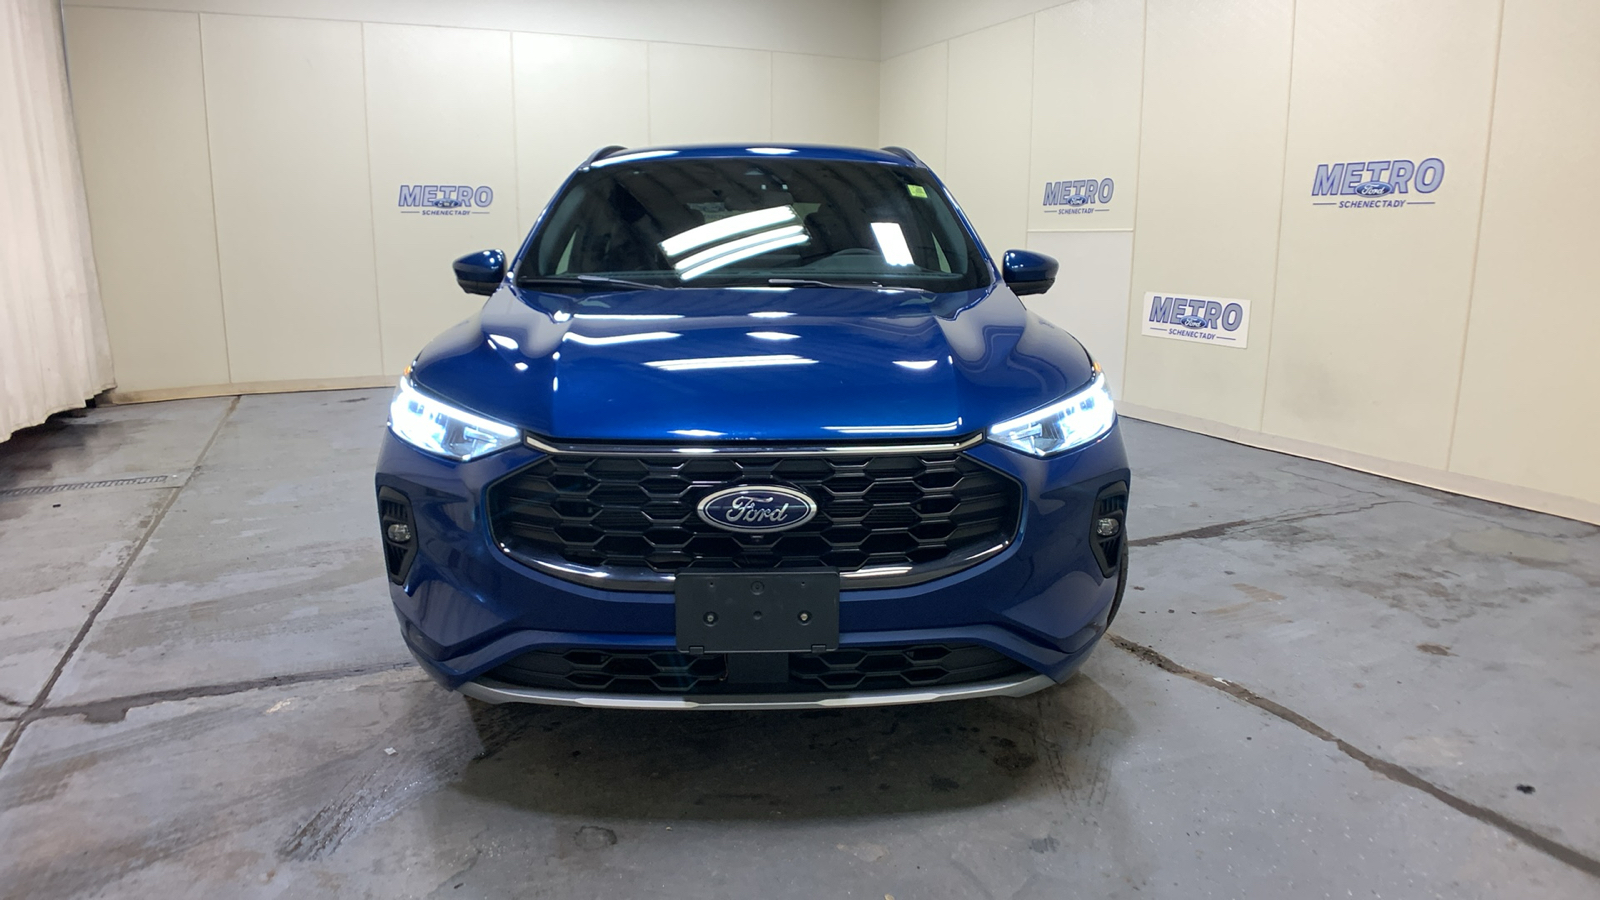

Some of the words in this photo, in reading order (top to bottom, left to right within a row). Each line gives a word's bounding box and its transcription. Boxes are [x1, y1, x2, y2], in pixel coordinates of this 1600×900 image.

[1311, 157, 1445, 196] METRO
[398, 185, 493, 208] METRO
[1043, 177, 1115, 206] METRO
[1338, 200, 1406, 209] SCHENECTADY
[1148, 296, 1243, 332] METRO
[1168, 328, 1216, 340] SCHENECTADY
[725, 495, 789, 522] Ford
